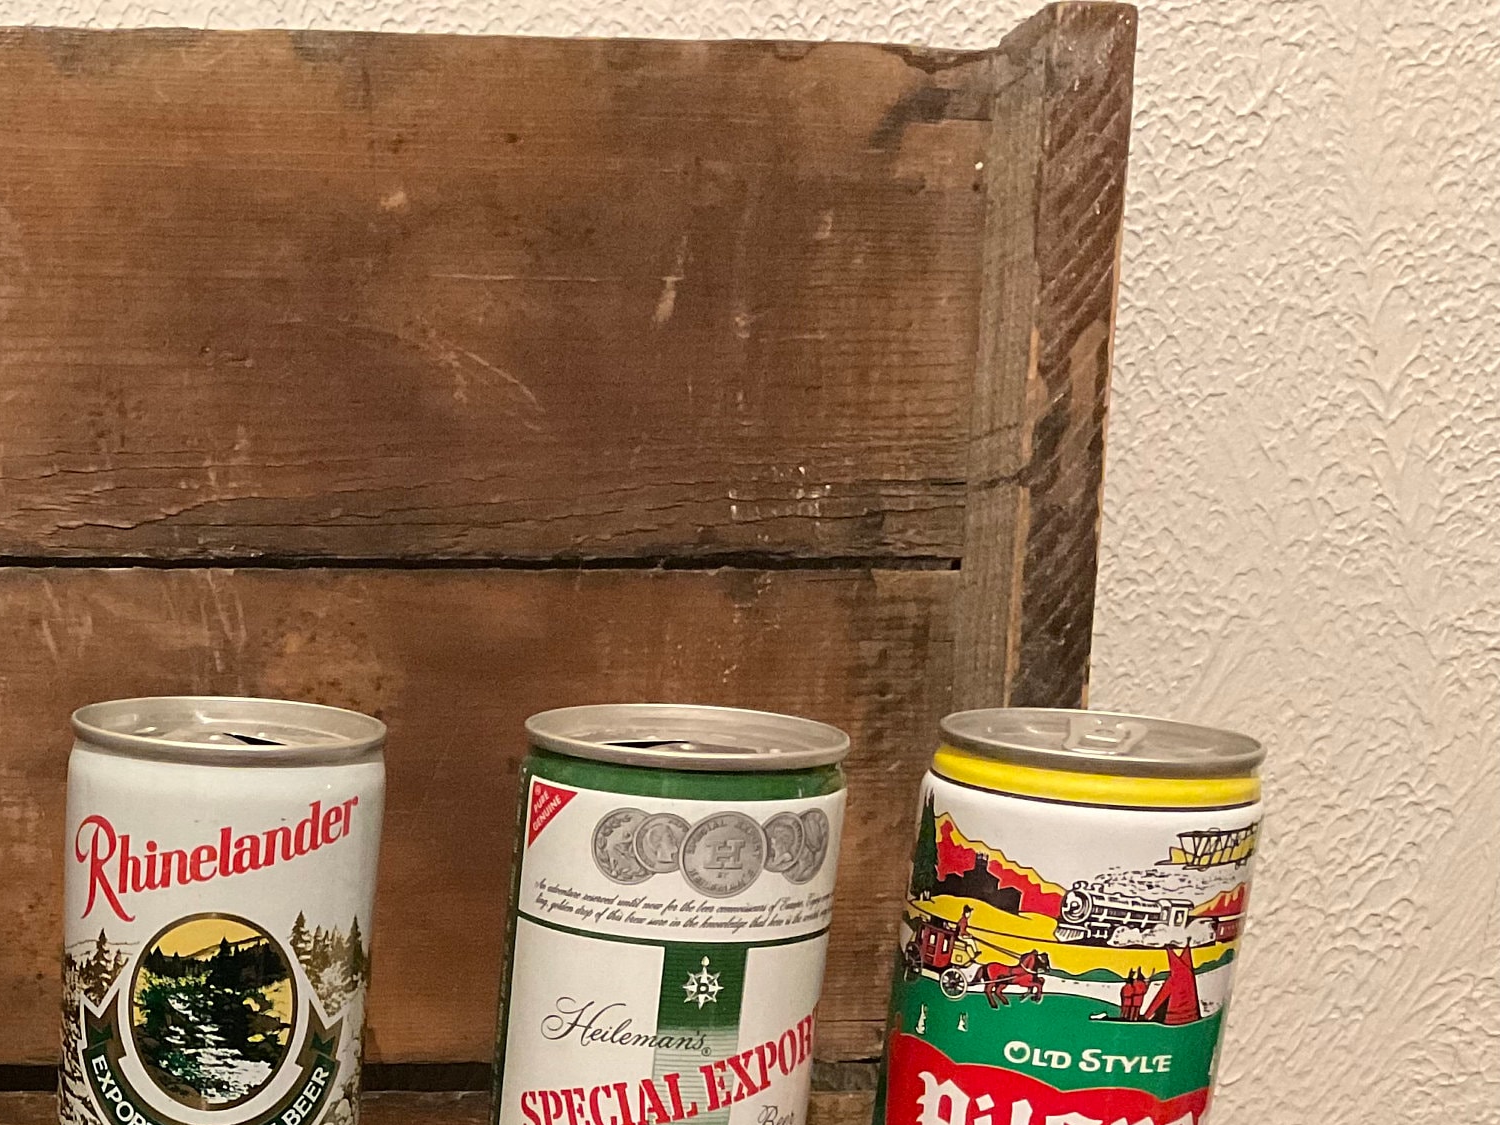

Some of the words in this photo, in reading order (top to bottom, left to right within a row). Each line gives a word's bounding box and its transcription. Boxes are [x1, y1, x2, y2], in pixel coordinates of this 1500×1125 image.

[532, 794, 562, 831] GENUINE
[75, 796, 359, 922] Rhinelander
[541, 996, 707, 1051] Heileman's
[699, 1014, 815, 1112] EXPOR
[1003, 1040, 1068, 1071] OLD
[1078, 1049, 1172, 1074] STYLE
